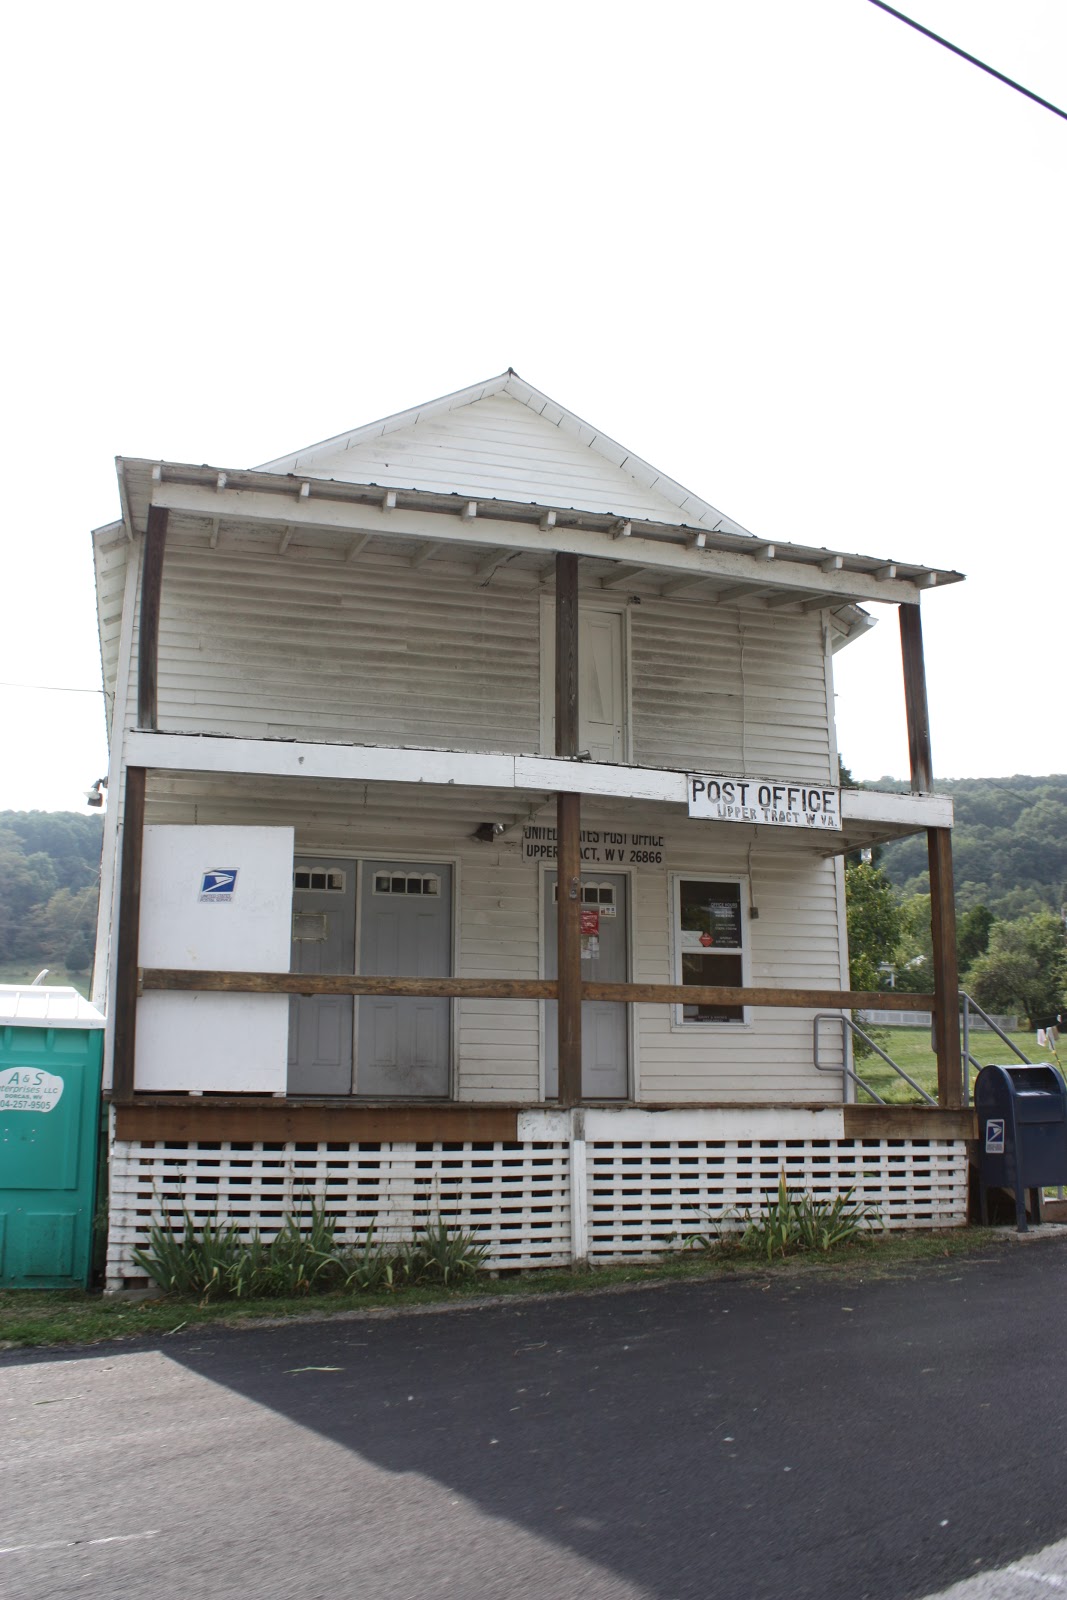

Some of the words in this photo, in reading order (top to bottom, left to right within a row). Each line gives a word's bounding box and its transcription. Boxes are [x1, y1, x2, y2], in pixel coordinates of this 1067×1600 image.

[692, 779, 750, 806] POST
[758, 785, 836, 813] OFFICE
[717, 803, 757, 820] UPPER
[760, 807, 801, 823] TRACT
[629, 850, 663, 864] 26866
[7, 1072, 19, 1084] A
[32, 1072, 45, 1085] S
[0, 1099, 51, 1110] 04-257-9505
